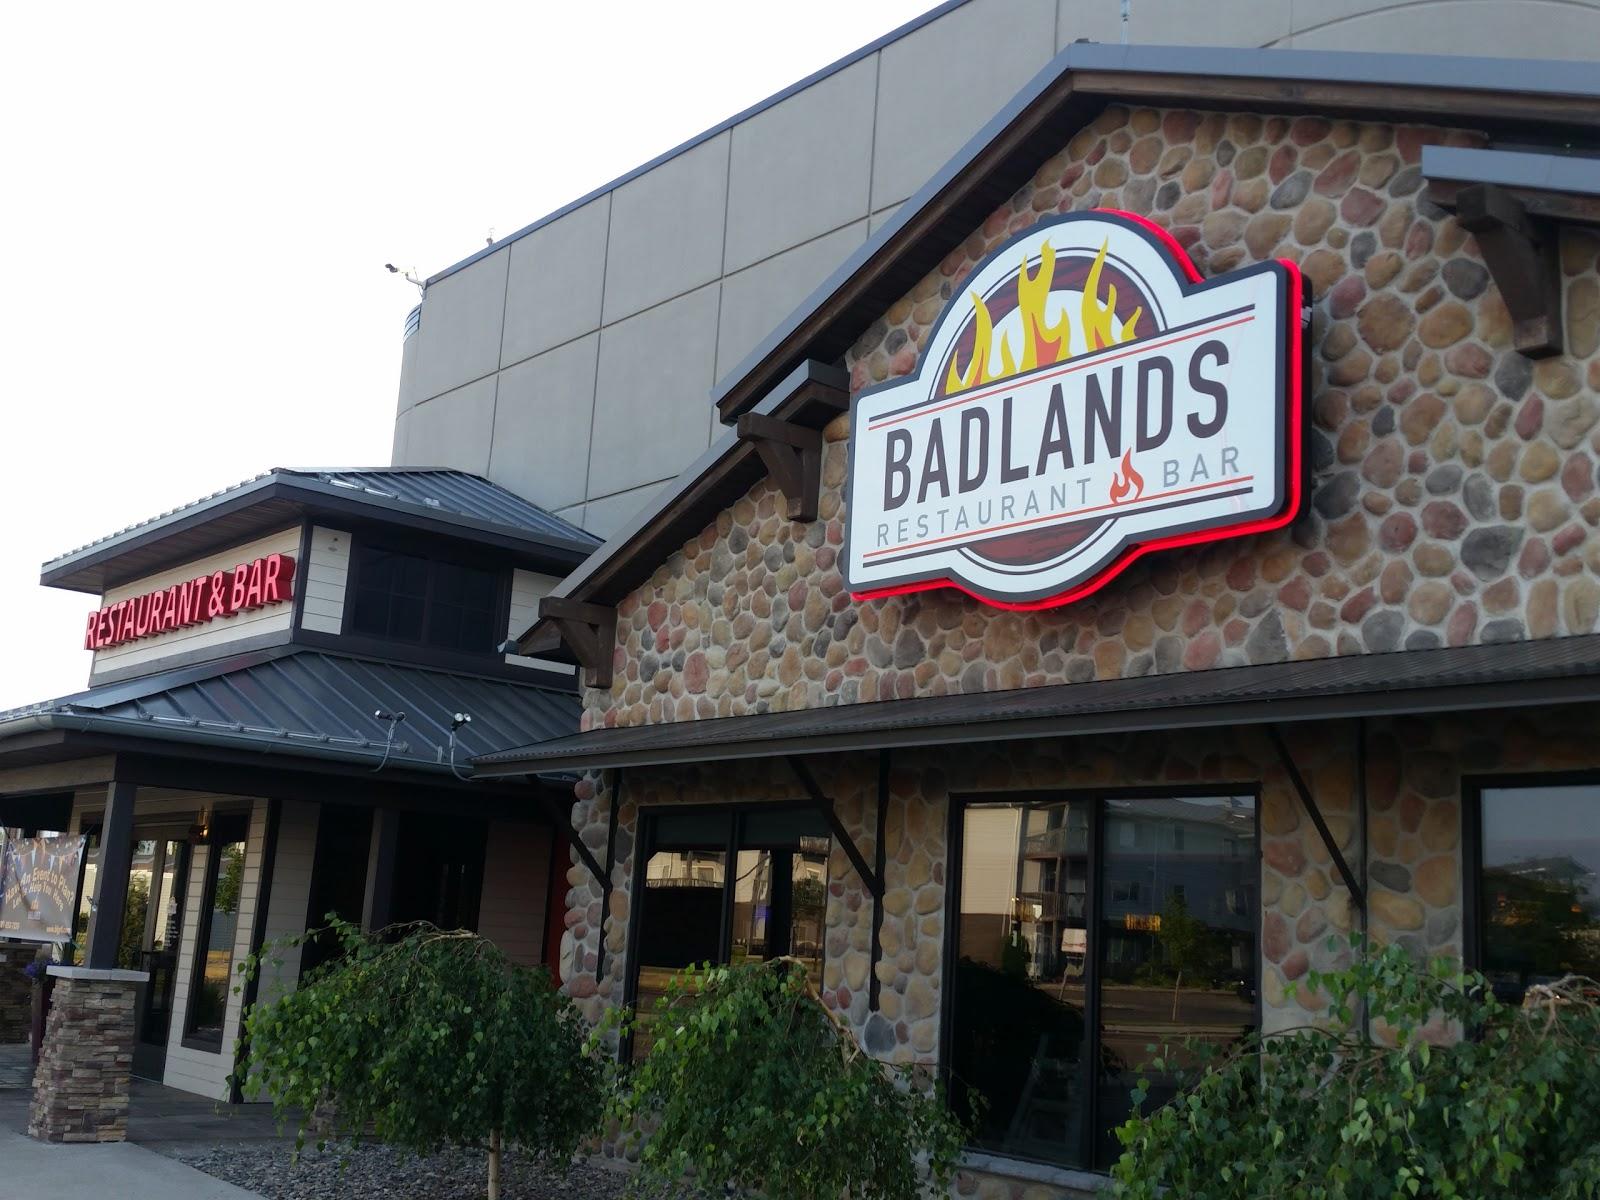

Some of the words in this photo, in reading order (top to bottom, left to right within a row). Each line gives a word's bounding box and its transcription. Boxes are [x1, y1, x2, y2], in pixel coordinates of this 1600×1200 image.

[883, 339, 1230, 512] BADLANDS
[876, 478, 1092, 548] RESTAURANT
[1163, 446, 1240, 488] BAR
[84, 575, 208, 650] RESTAURANT
[208, 570, 227, 618] &
[231, 553, 284, 612] BAR
[20, 872, 31, 885] An
[32, 867, 50, 881] Event
[58, 874, 75, 905] Plan?
